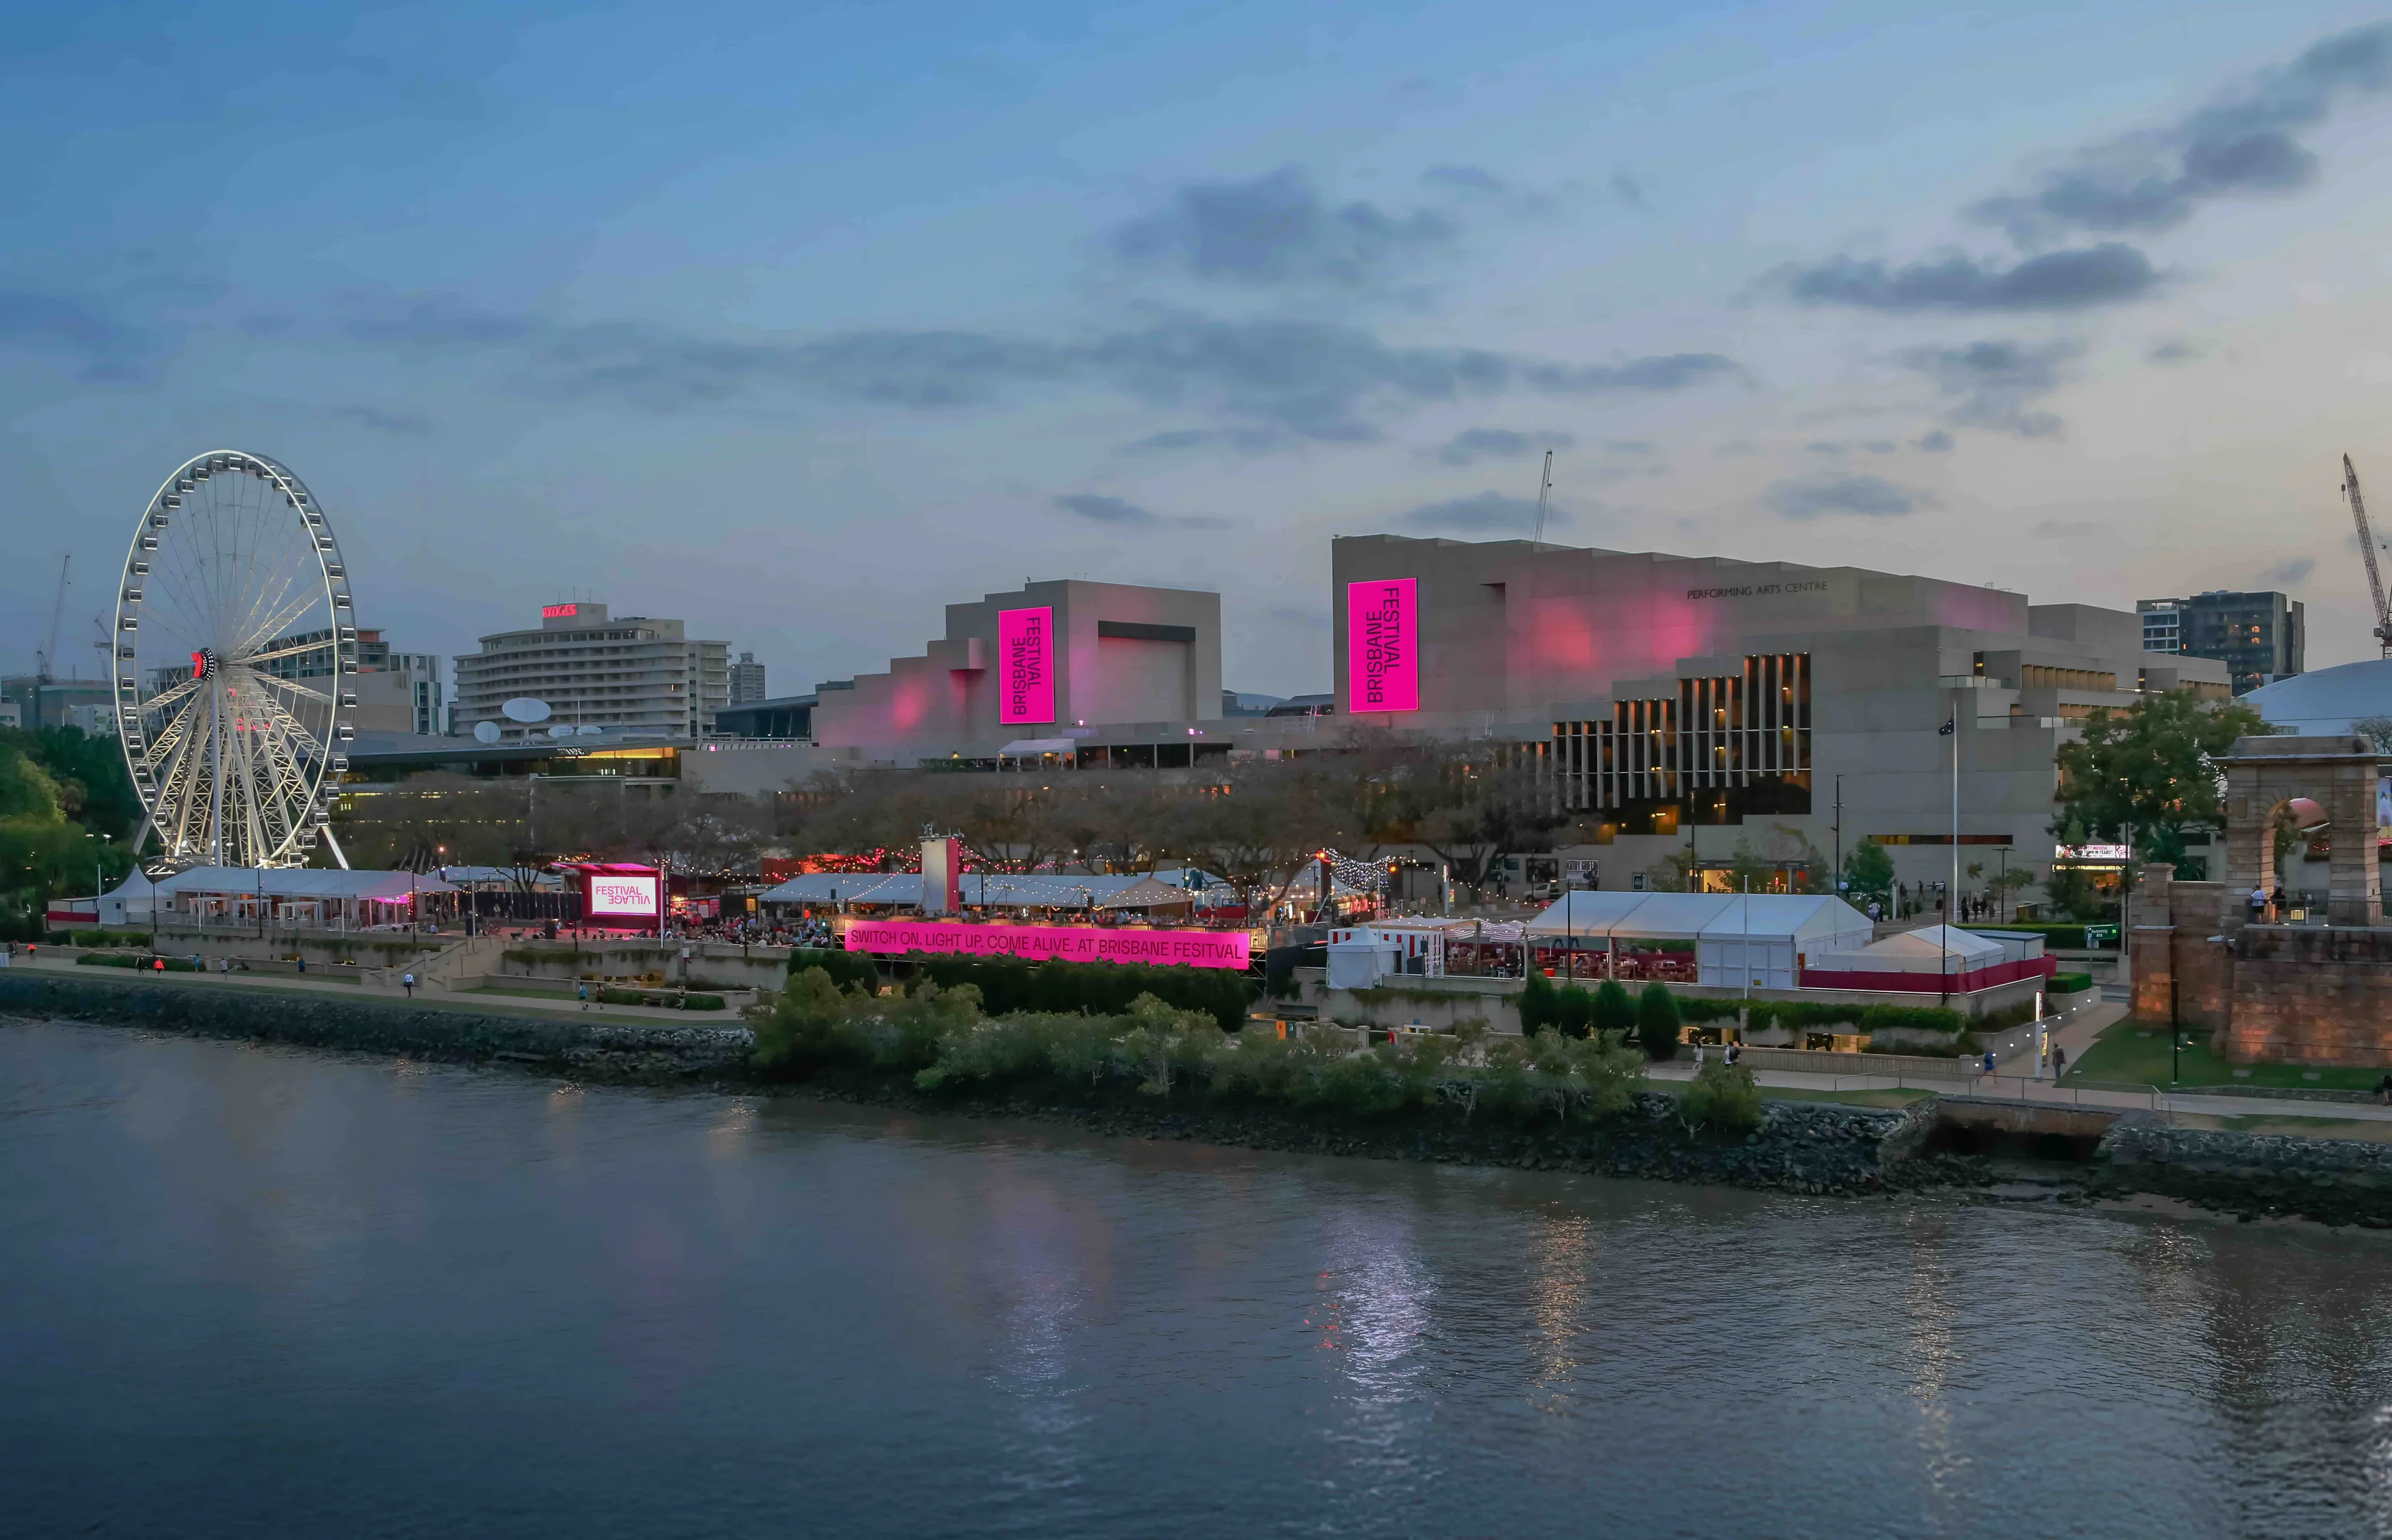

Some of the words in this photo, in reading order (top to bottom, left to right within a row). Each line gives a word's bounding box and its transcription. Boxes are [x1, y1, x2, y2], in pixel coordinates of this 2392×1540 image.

[1688, 585, 1752, 600] PERFORMING
[1756, 584, 1781, 595] ARTS
[1785, 581, 1828, 593] CENTRE
[543, 604, 578, 618] RYDGES
[1383, 587, 1400, 674] FESTIVAL
[1027, 617, 1041, 690] FESTIVAL
[1366, 610, 1382, 703] BRISBANE
[1012, 637, 1027, 715] BRISBANE
[595, 886, 642, 895] FESTIVAL
[608, 895, 650, 904] VILLAGE
[851, 930, 896, 945] SWITCH
[900, 932, 922, 945] ON.
[926, 933, 961, 947] LIGHT
[965, 935, 984, 948] UP.
[987, 935, 1030, 950] COME
[1033, 938, 1073, 953] ALIVE.
[1078, 938, 1094, 953] AT
[1099, 940, 1169, 956] BRISBANE
[1174, 942, 1243, 960] FESITVAL
